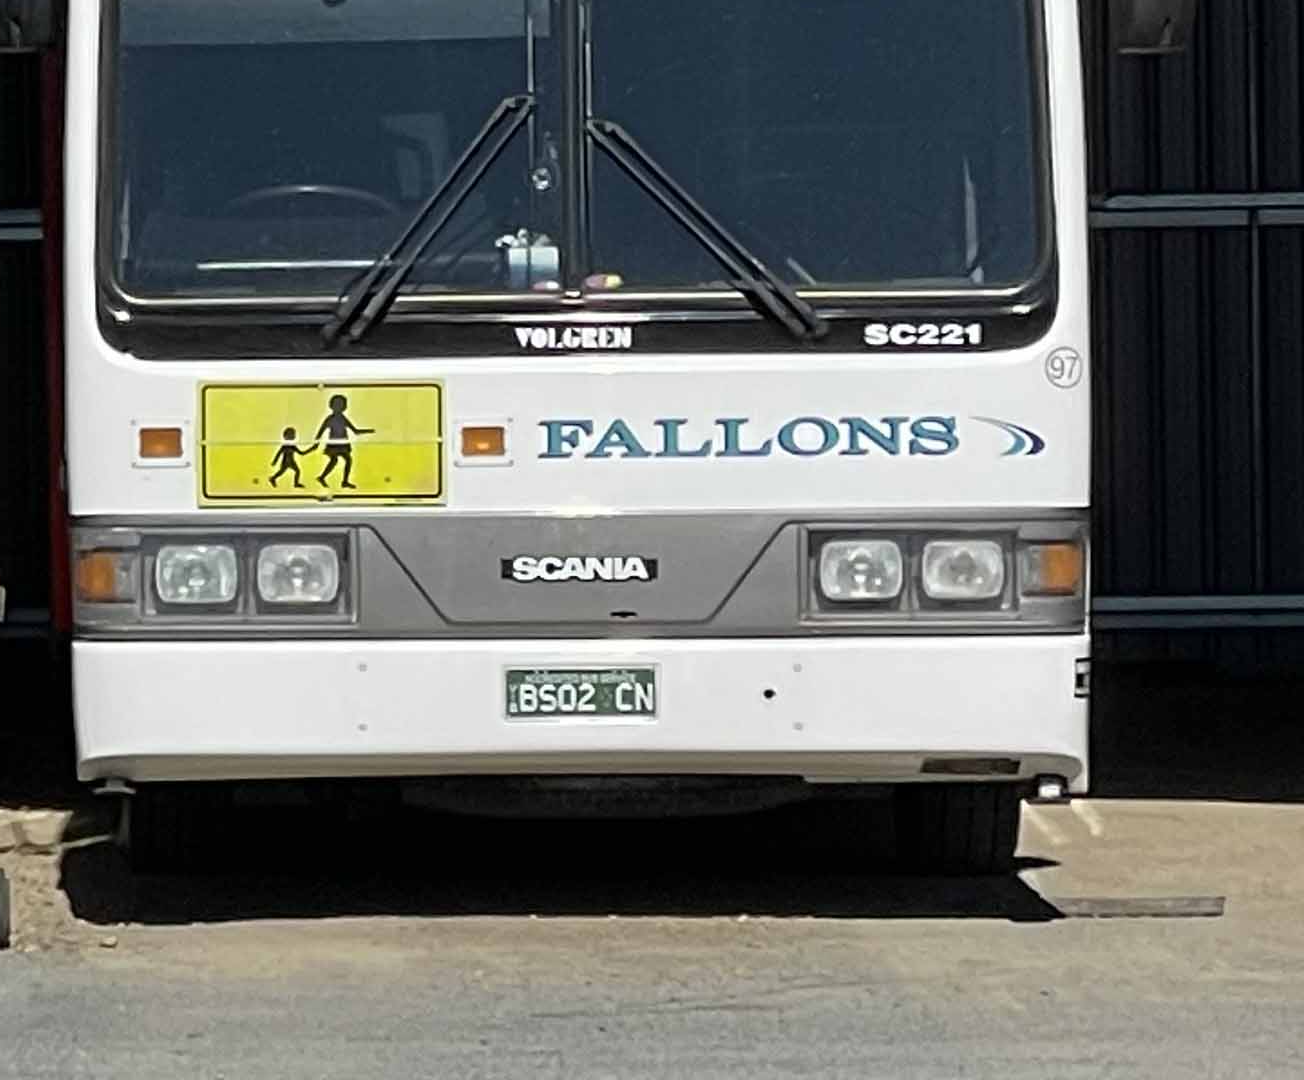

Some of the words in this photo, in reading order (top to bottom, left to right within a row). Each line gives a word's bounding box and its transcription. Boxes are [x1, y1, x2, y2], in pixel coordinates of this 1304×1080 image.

[514, 326, 633, 350] VOLGREN
[863, 322, 982, 346] SC221
[1049, 354, 1078, 381] 97
[537, 415, 960, 459] FALLONS
[511, 556, 649, 581] SCANIA
[519, 682, 596, 712] BS02
[615, 682, 654, 711] CN
